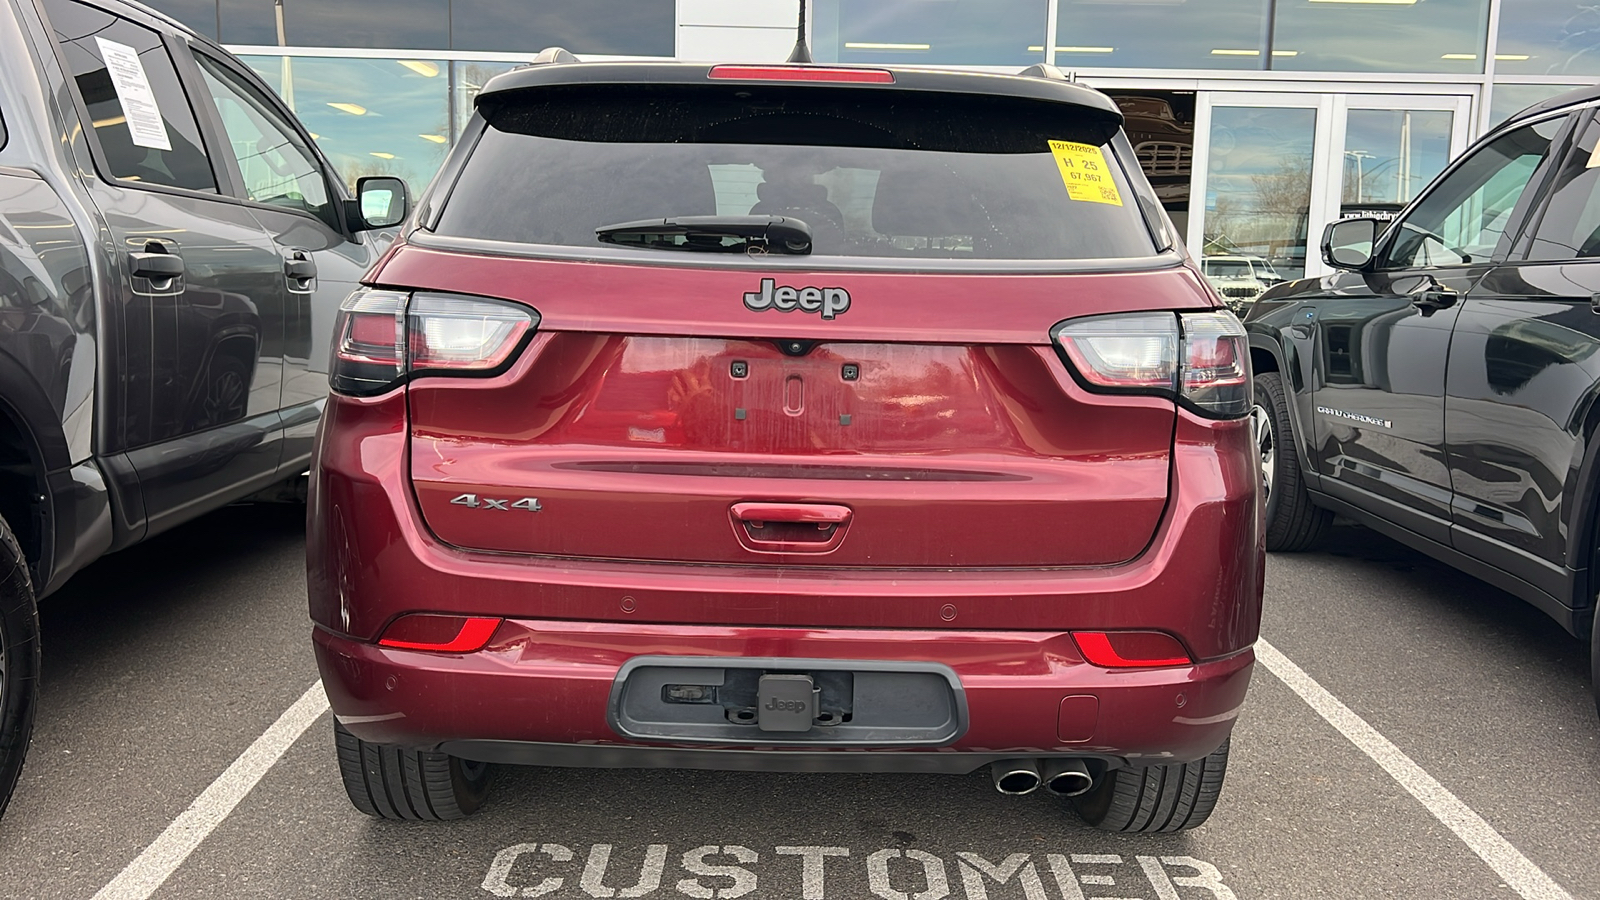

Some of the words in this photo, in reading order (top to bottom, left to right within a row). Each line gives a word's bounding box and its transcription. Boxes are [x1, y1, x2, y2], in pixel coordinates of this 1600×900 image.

[1052, 142, 1098, 155] 12/12/2025
[1063, 157, 1074, 168] H
[1081, 159, 1099, 171] 25
[743, 278, 851, 320] Jeep
[1317, 406, 1342, 417] GRAND
[1342, 411, 1384, 427] CHEROKEE
[450, 494, 542, 512] 4x4
[765, 696, 806, 714] Jeep
[480, 843, 1238, 900] CUSTOMER
